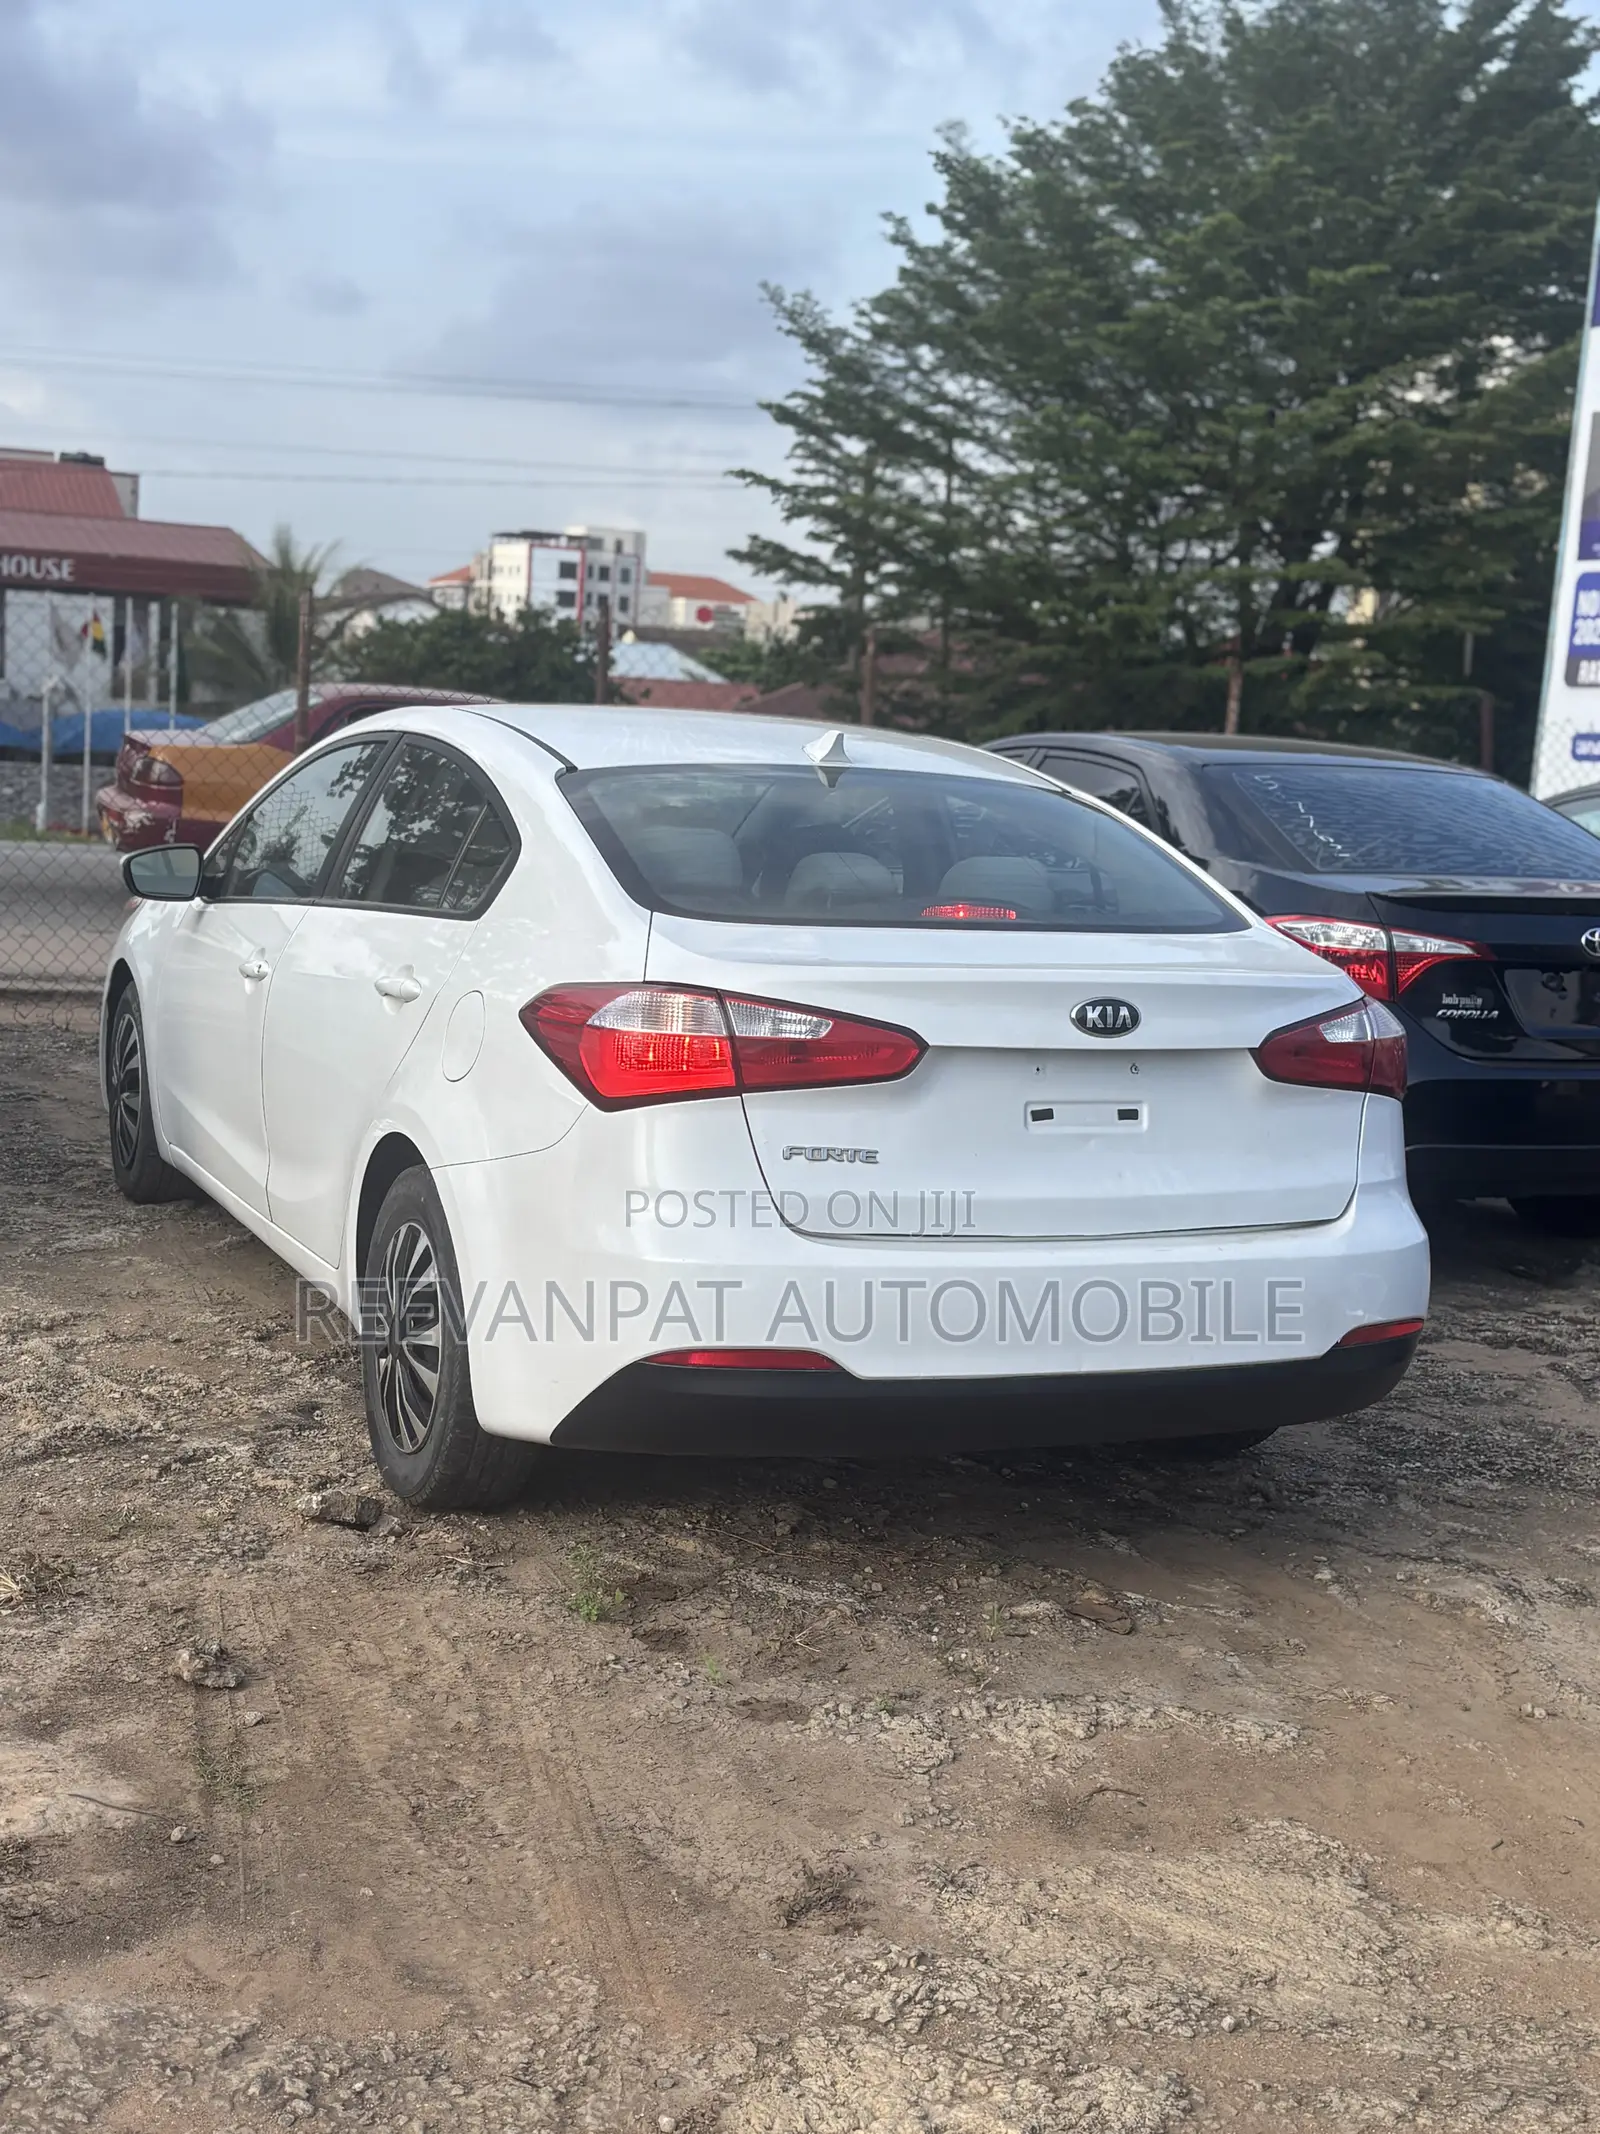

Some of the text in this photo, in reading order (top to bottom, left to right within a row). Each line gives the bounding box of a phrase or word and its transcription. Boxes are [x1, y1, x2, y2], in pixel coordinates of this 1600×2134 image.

[0, 554, 76, 581] HOUSE
[1085, 1005, 1132, 1028] KIA
[782, 1145, 879, 1164] FORTE
